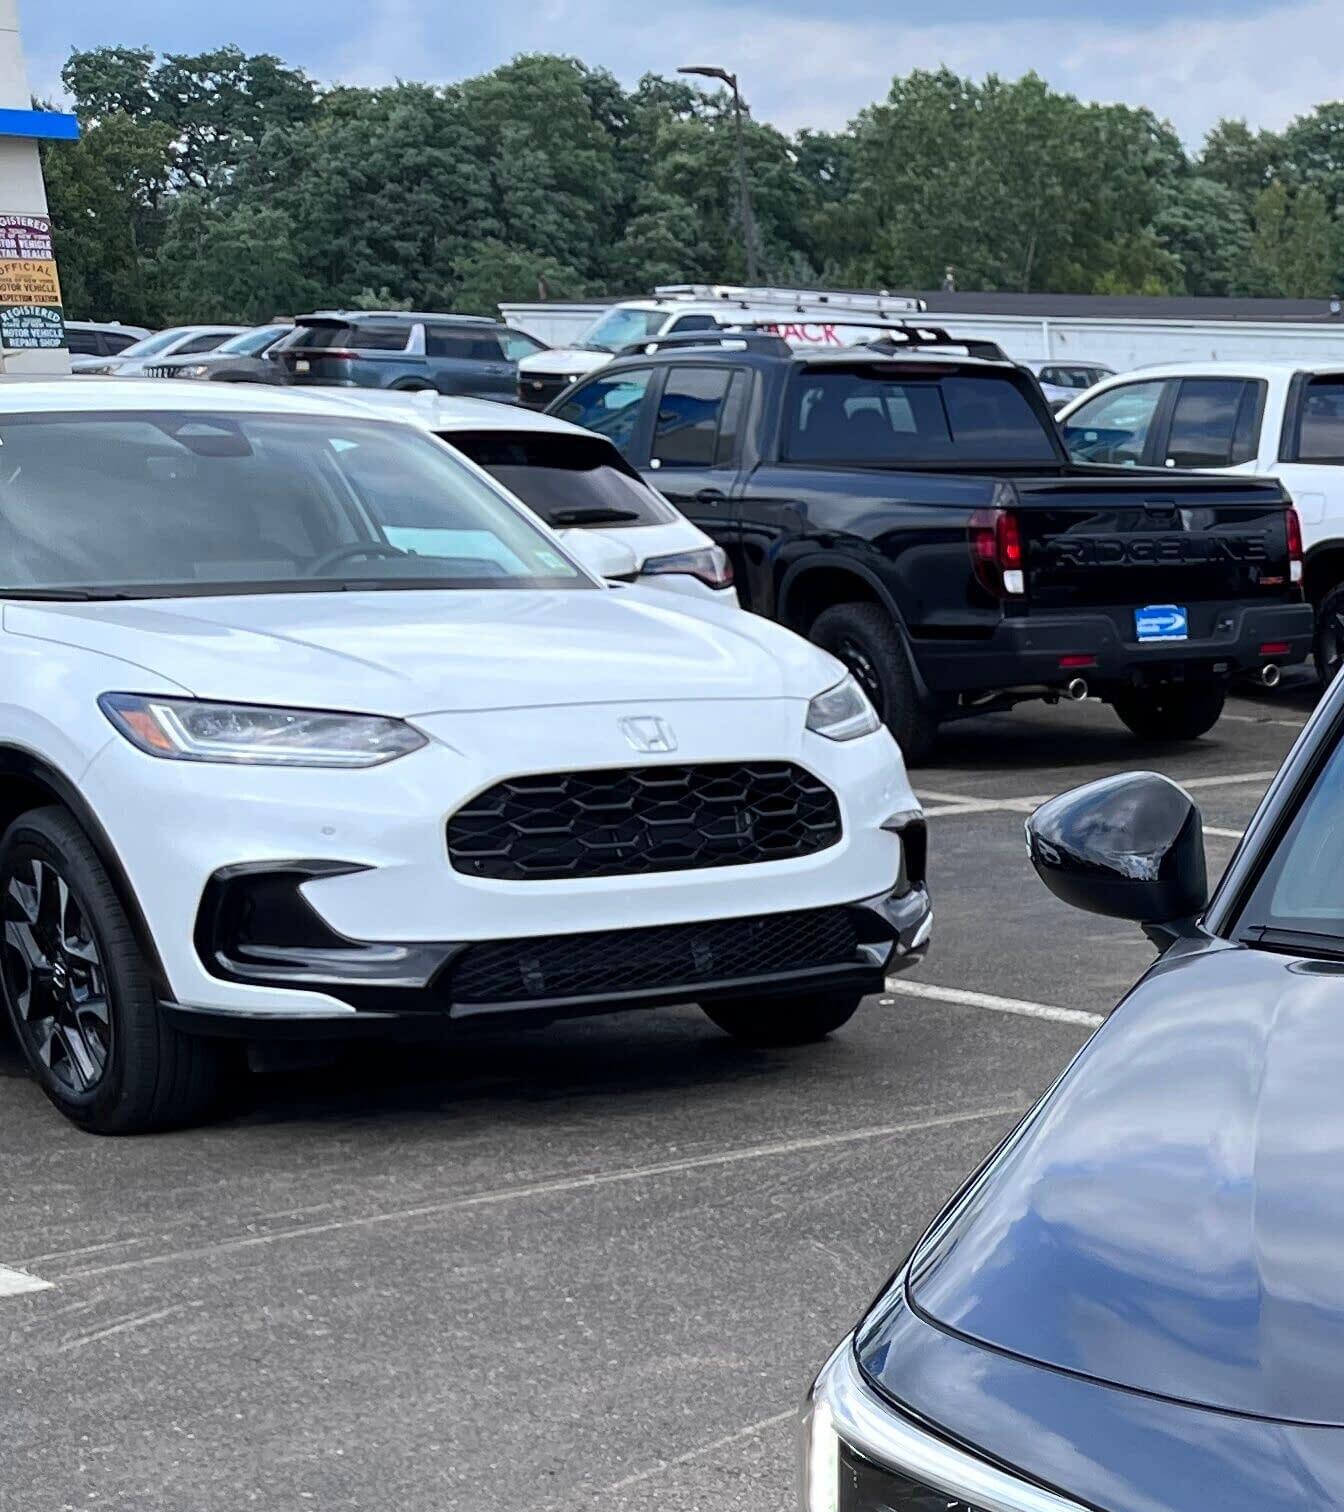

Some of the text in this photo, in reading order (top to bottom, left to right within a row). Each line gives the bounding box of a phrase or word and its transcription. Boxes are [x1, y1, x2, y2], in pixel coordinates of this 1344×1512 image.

[19, 239, 52, 249] VEHICLE
[24, 284, 57, 293] VEHICLE
[0, 306, 60, 322] REGISTERED
[3, 328, 64, 339] MOTOR VEHICLE
[9, 338, 61, 348] REPAIR SHOP
[1054, 537, 1268, 566] RIDGELINE
